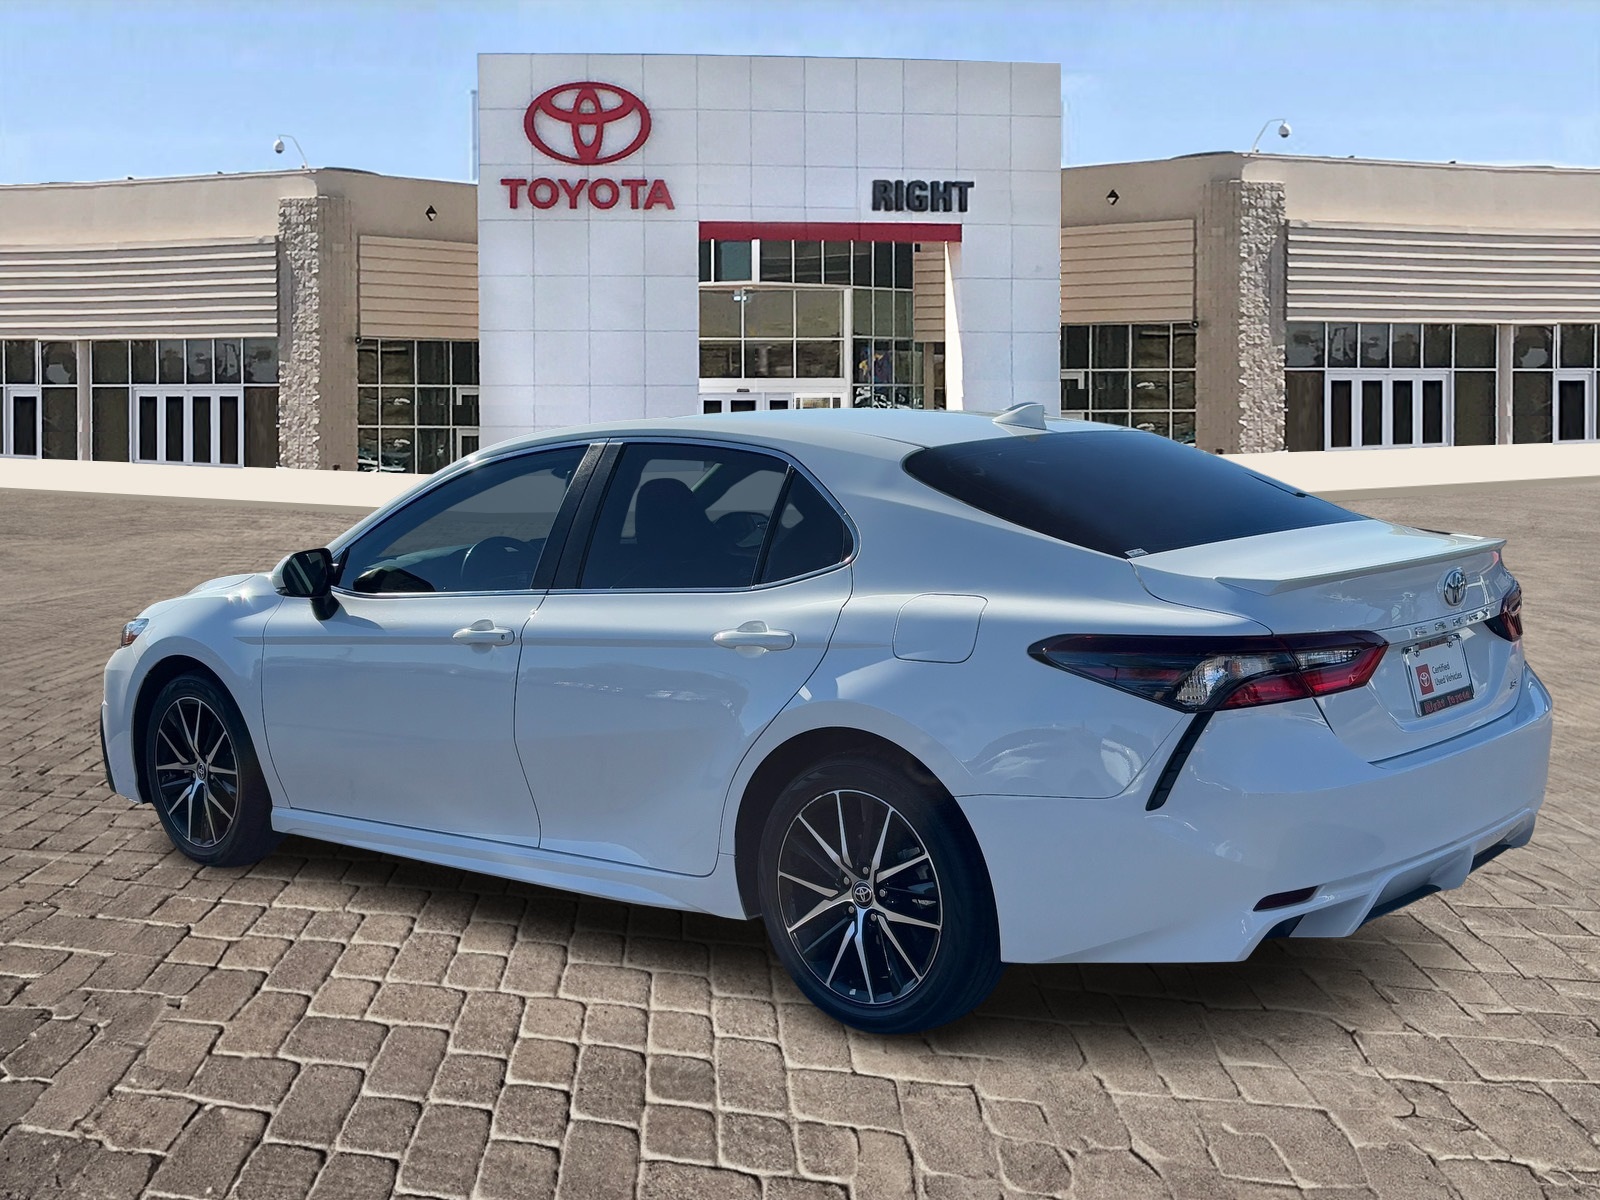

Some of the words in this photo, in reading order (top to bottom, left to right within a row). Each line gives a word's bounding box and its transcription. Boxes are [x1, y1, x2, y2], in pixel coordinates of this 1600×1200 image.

[501, 178, 675, 209] TOYOTA
[872, 179, 975, 212] RIGHT
[1431, 661, 1450, 674] Certified
[1434, 675, 1446, 686] Used
[1445, 671, 1462, 683] Vehicles
